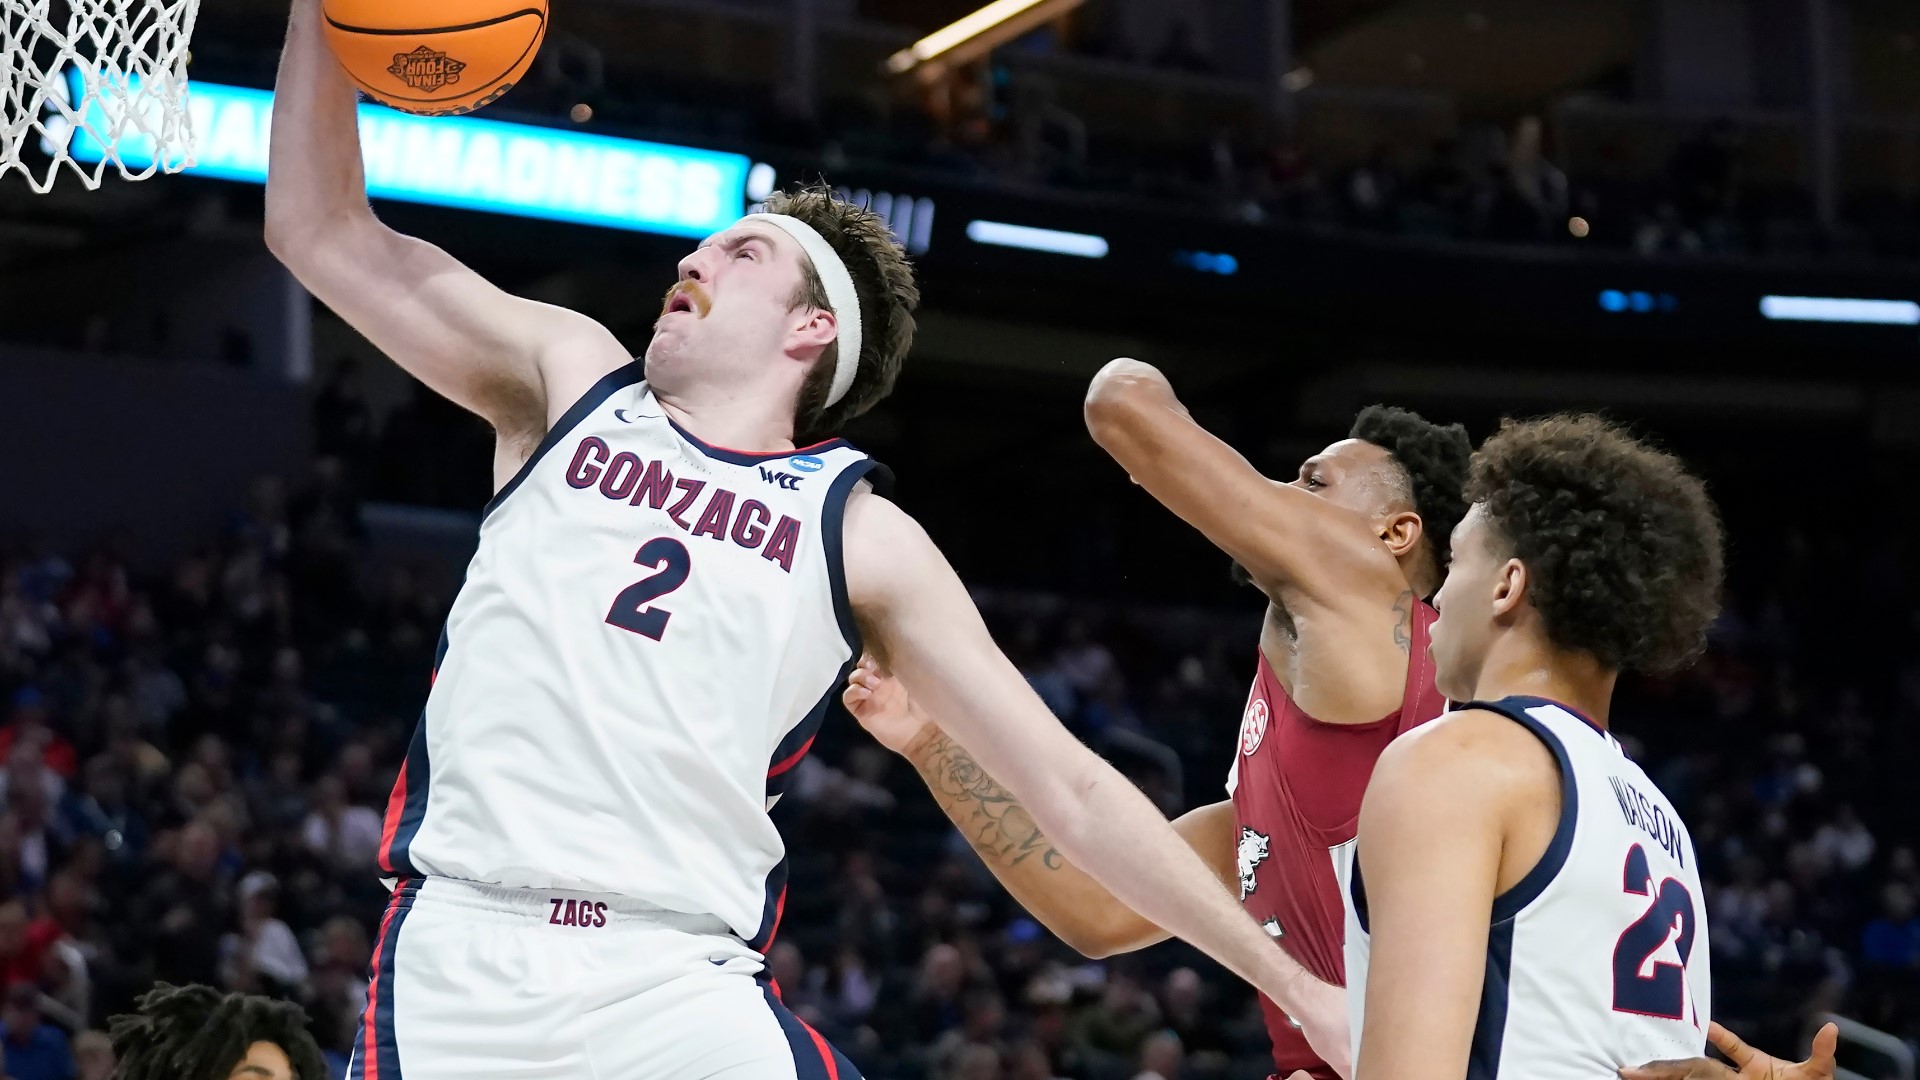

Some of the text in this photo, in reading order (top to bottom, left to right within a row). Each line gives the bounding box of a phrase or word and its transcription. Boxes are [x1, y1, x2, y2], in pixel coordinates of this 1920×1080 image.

[405, 60, 445, 75] FOUR
[406, 74, 445, 87] FINAL
[759, 466, 805, 490] WCC
[566, 436, 801, 573] GONZAGA
[605, 537, 691, 642] 2
[1244, 703, 1265, 749] SEC
[1608, 776, 1683, 869] WATSON
[549, 899, 608, 928] ZAGS
